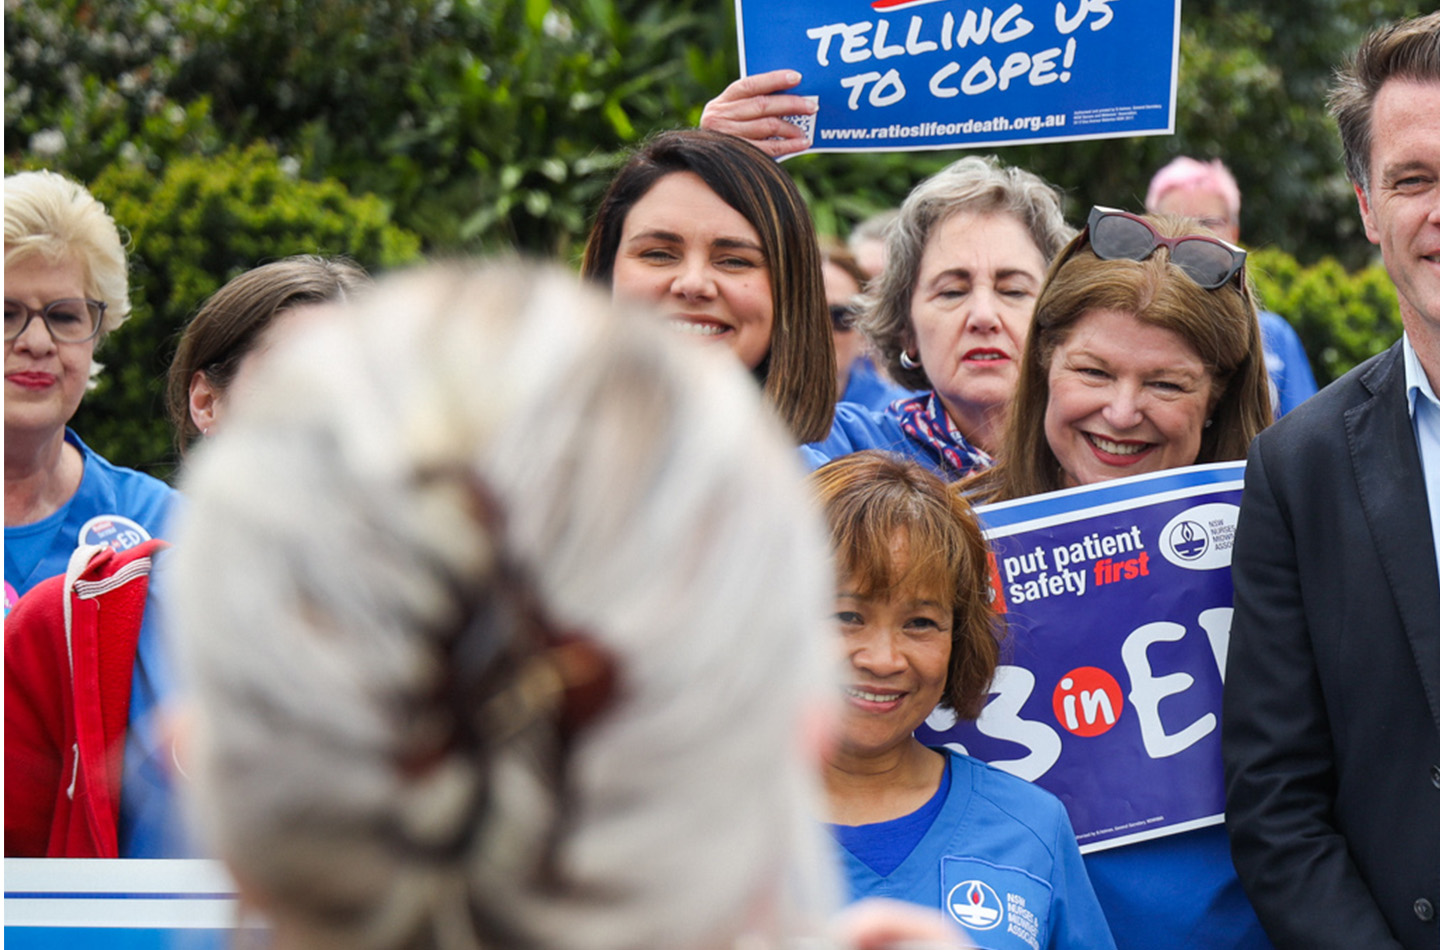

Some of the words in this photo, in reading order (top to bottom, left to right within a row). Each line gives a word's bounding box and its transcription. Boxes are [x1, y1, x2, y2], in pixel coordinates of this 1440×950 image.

[806, 3, 1034, 66] TELLING
[1055, 0, 1114, 35] US
[840, 69, 906, 110] TO
[929, 37, 1077, 98] COPE!
[820, 113, 1066, 140] www.ratioslifeordeath.org.au
[1003, 547, 1047, 582] put
[1053, 526, 1144, 567] patient
[1010, 567, 1087, 604] safety
[1093, 551, 1150, 586] first
[1060, 678, 1116, 730] in
